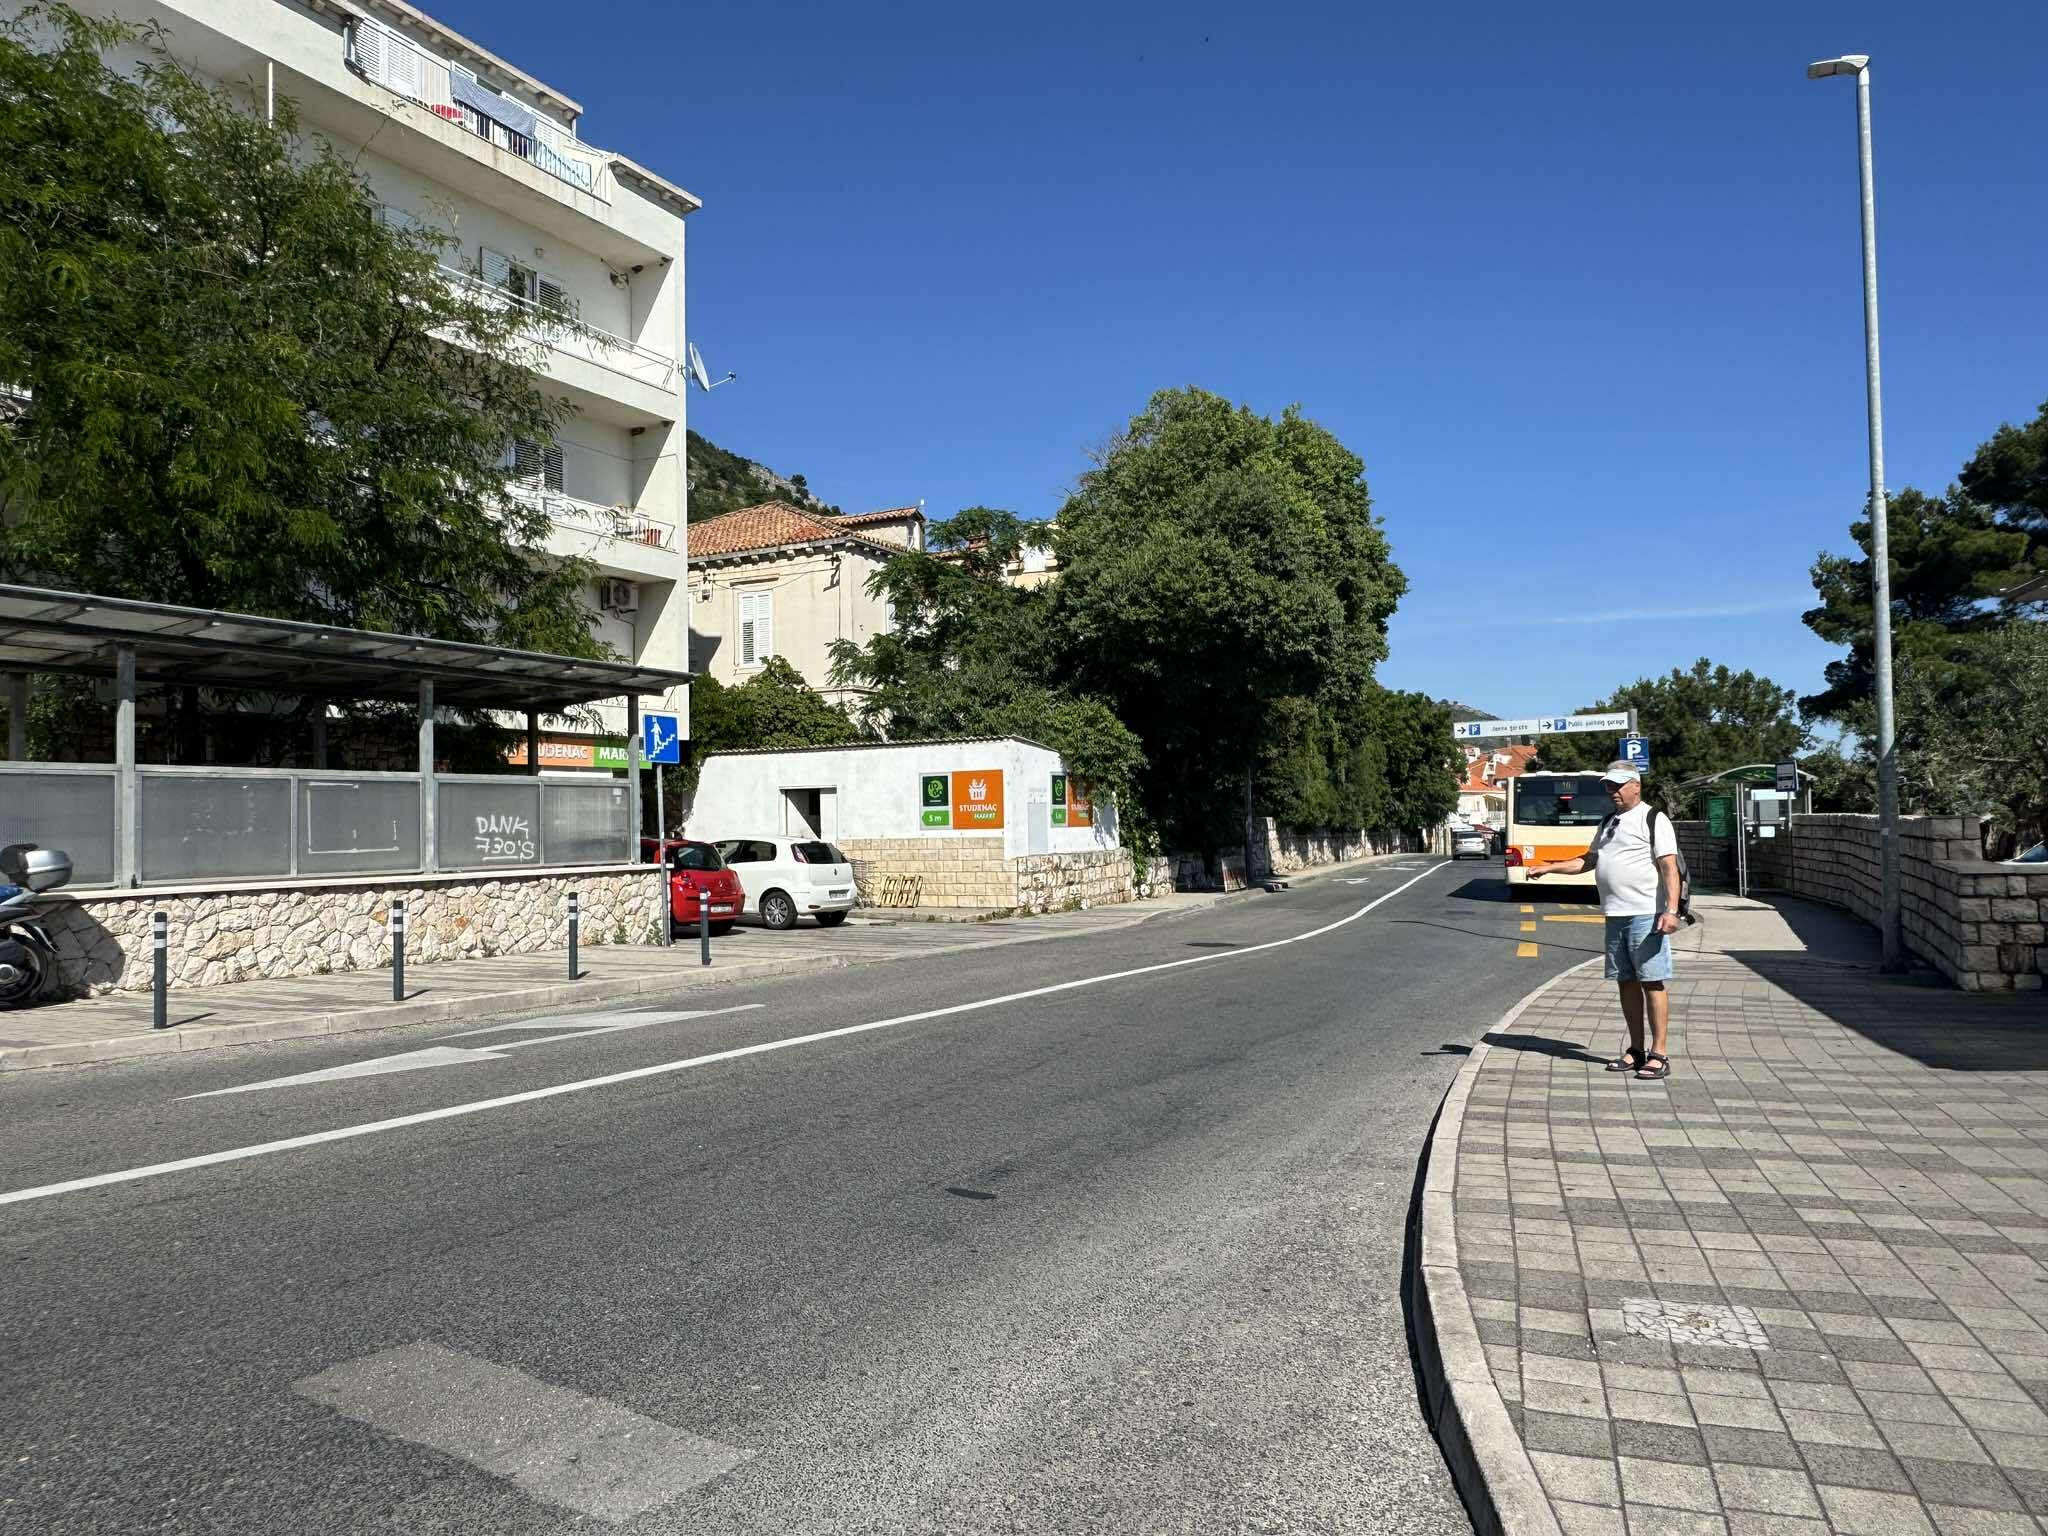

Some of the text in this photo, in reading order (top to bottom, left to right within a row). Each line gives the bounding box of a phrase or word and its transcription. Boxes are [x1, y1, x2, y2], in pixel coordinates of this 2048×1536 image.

[522, 742, 588, 760] SUDENAC
[959, 803, 998, 812] STUDENAC
[476, 814, 529, 840] DANK
